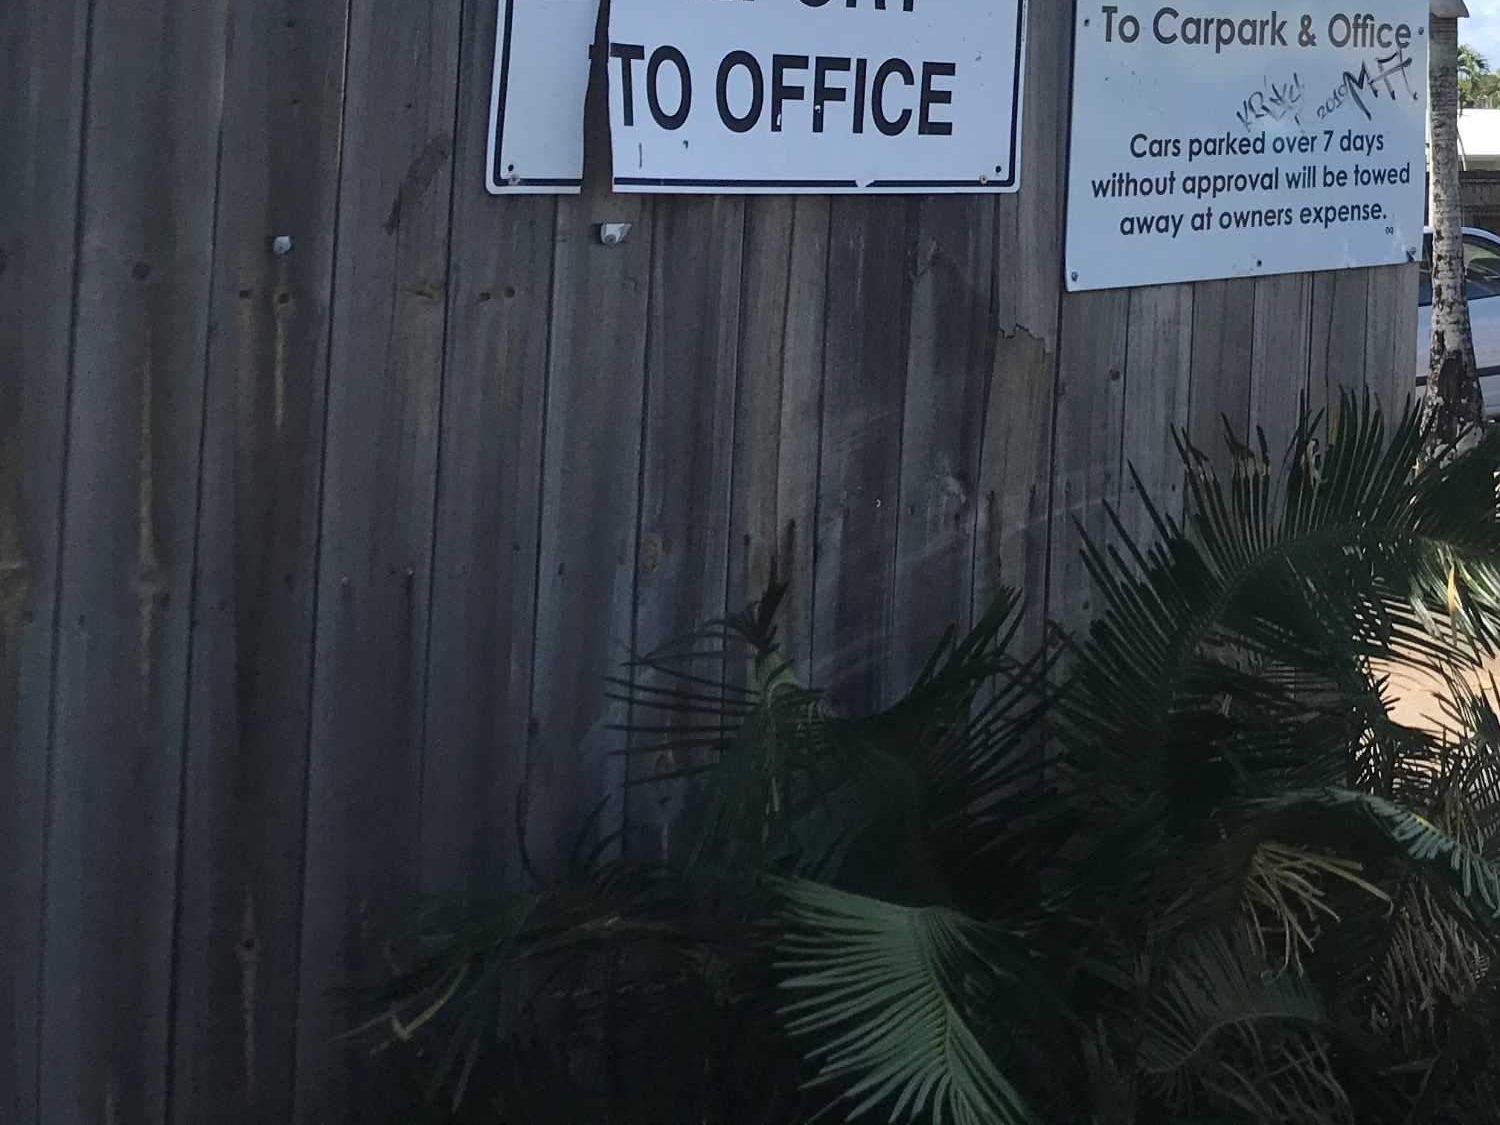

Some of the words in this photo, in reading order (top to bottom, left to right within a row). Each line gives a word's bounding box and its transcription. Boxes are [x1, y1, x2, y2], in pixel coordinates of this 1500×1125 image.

[1101, 5, 1140, 44] To
[1152, 6, 1288, 54] Carpark
[1298, 14, 1317, 48] &
[1327, 12, 1413, 51] Office
[589, 42, 693, 131] TO
[715, 50, 956, 136] OFFICE
[1129, 132, 1181, 159] Cars
[1189, 130, 1266, 163] parked
[1272, 134, 1319, 154] over
[1323, 129, 1335, 153] 7
[1339, 128, 1385, 157] days
[1091, 170, 1177, 199] without
[1182, 166, 1280, 200] approval
[1285, 164, 1317, 190] will
[1322, 164, 1349, 188] be
[1353, 161, 1411, 187] towed
[1119, 213, 1184, 239] away
[1190, 206, 1213, 232] at
[1218, 208, 1293, 231] owners
[1299, 202, 1389, 229] expense.
